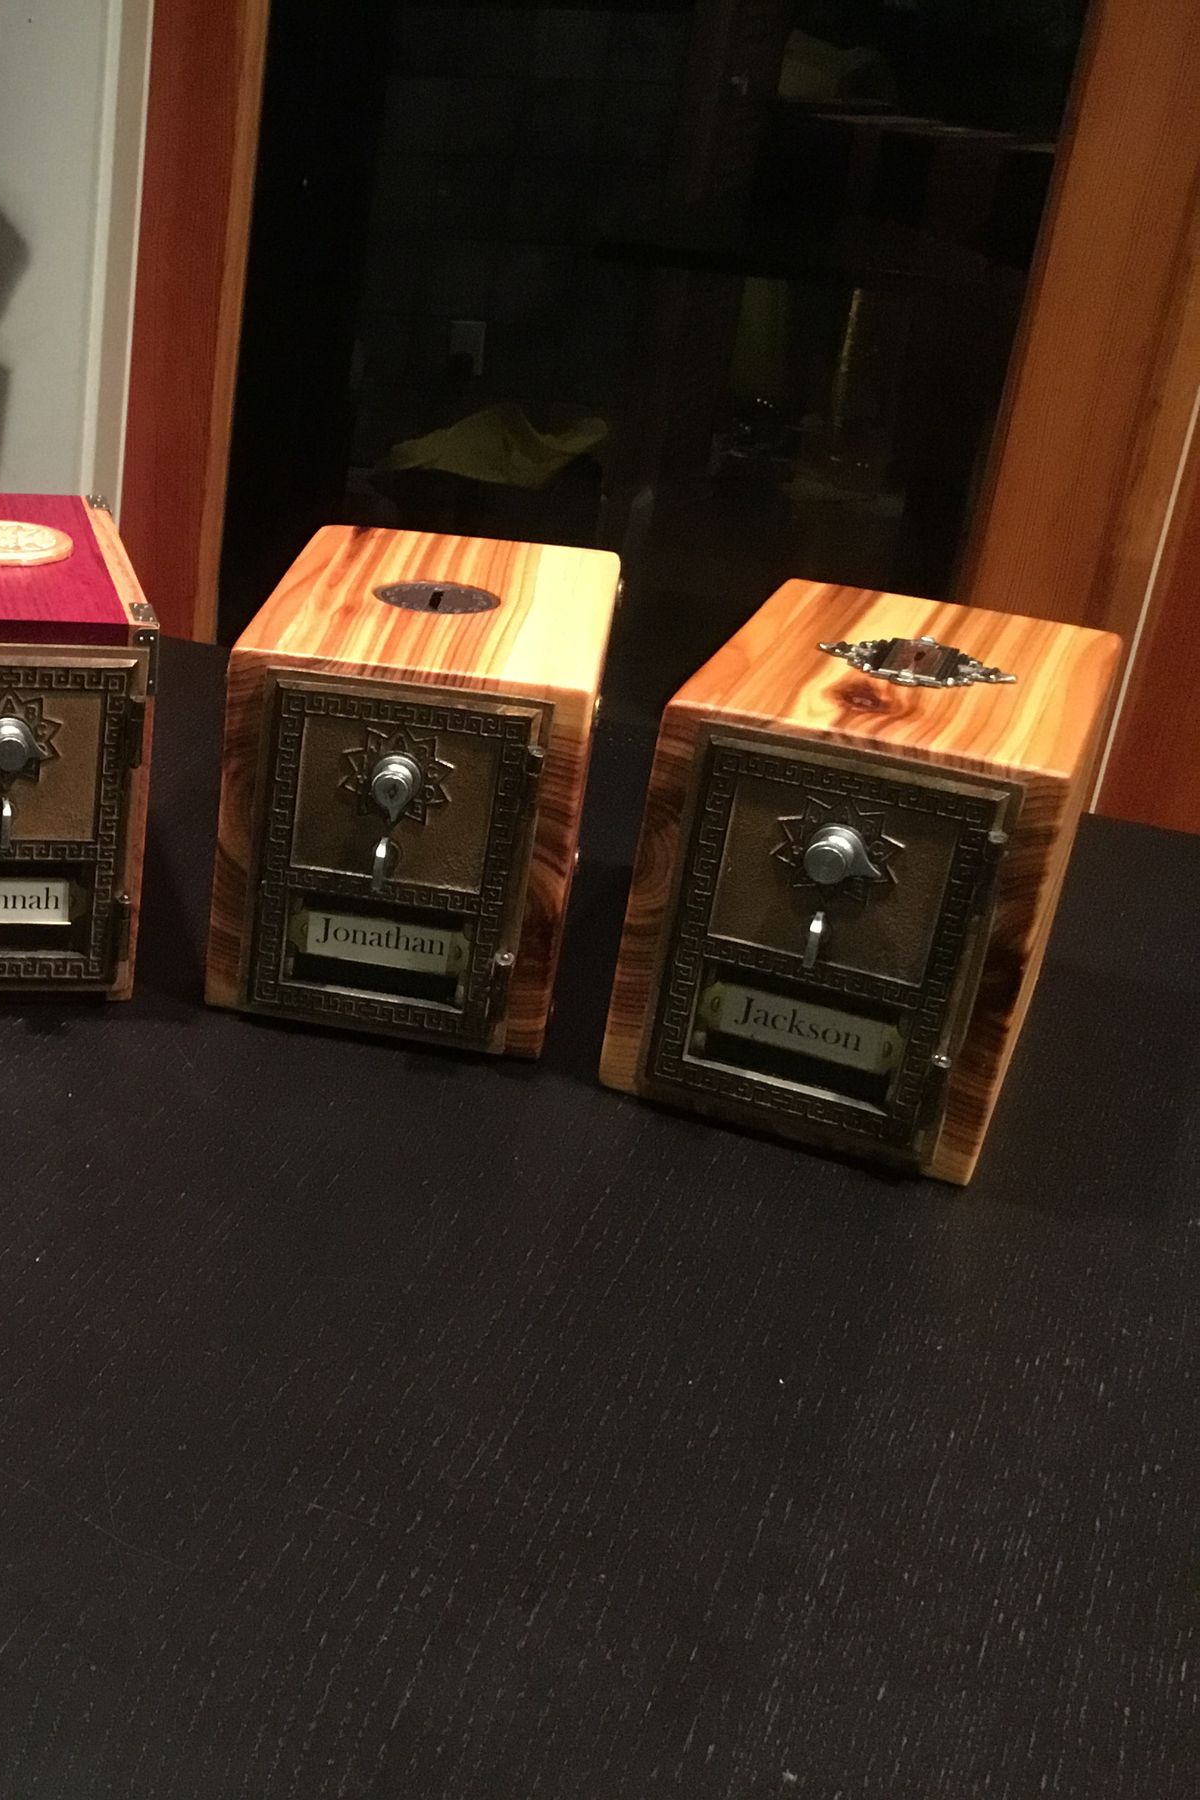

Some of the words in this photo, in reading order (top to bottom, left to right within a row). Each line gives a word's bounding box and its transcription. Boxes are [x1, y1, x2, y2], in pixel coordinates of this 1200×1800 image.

[1, 697, 17, 715] A
[316, 917, 445, 957] Jonathan
[734, 996, 863, 1052] Jackson
